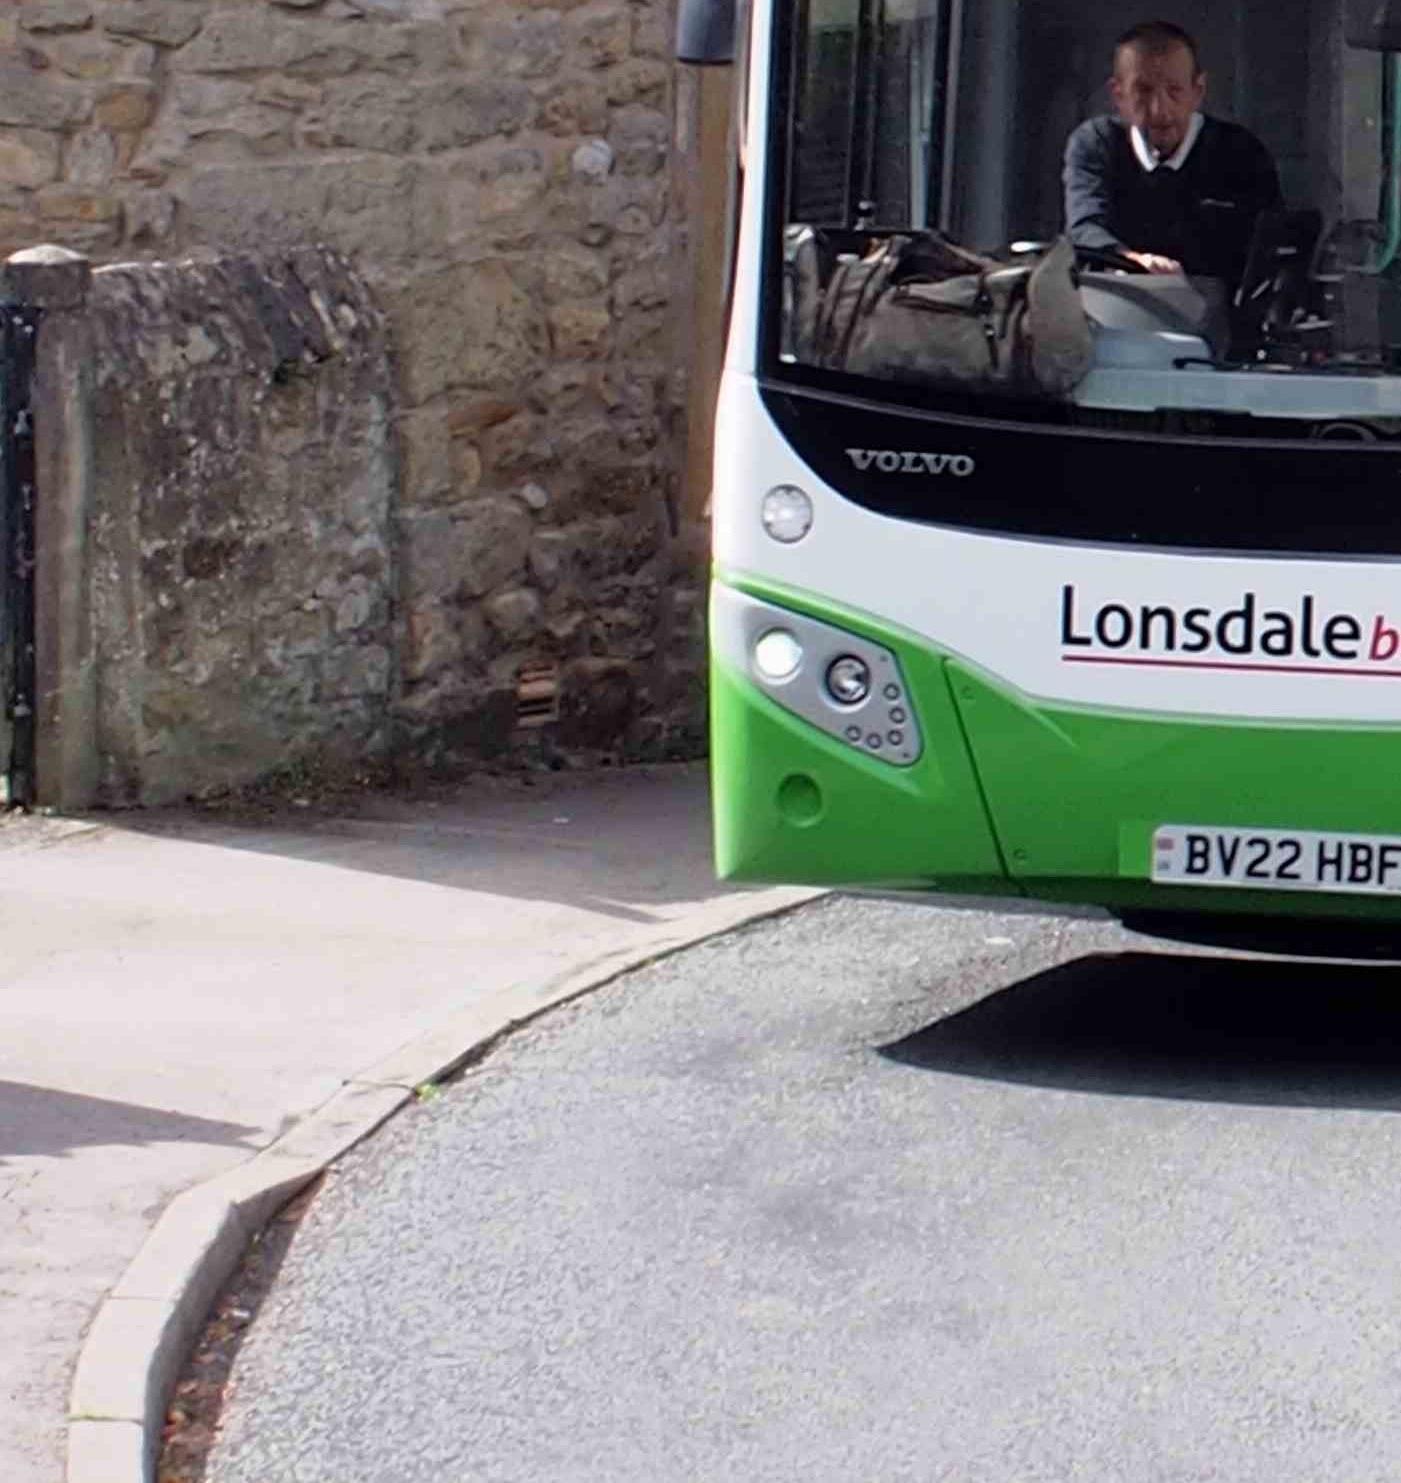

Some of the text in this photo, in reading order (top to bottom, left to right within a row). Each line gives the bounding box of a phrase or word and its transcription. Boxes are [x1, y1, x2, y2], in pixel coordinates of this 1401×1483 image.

[845, 448, 975, 477] VOLVO
[1061, 584, 1361, 660] Lonsdale
[1184, 834, 1303, 880] BV22
